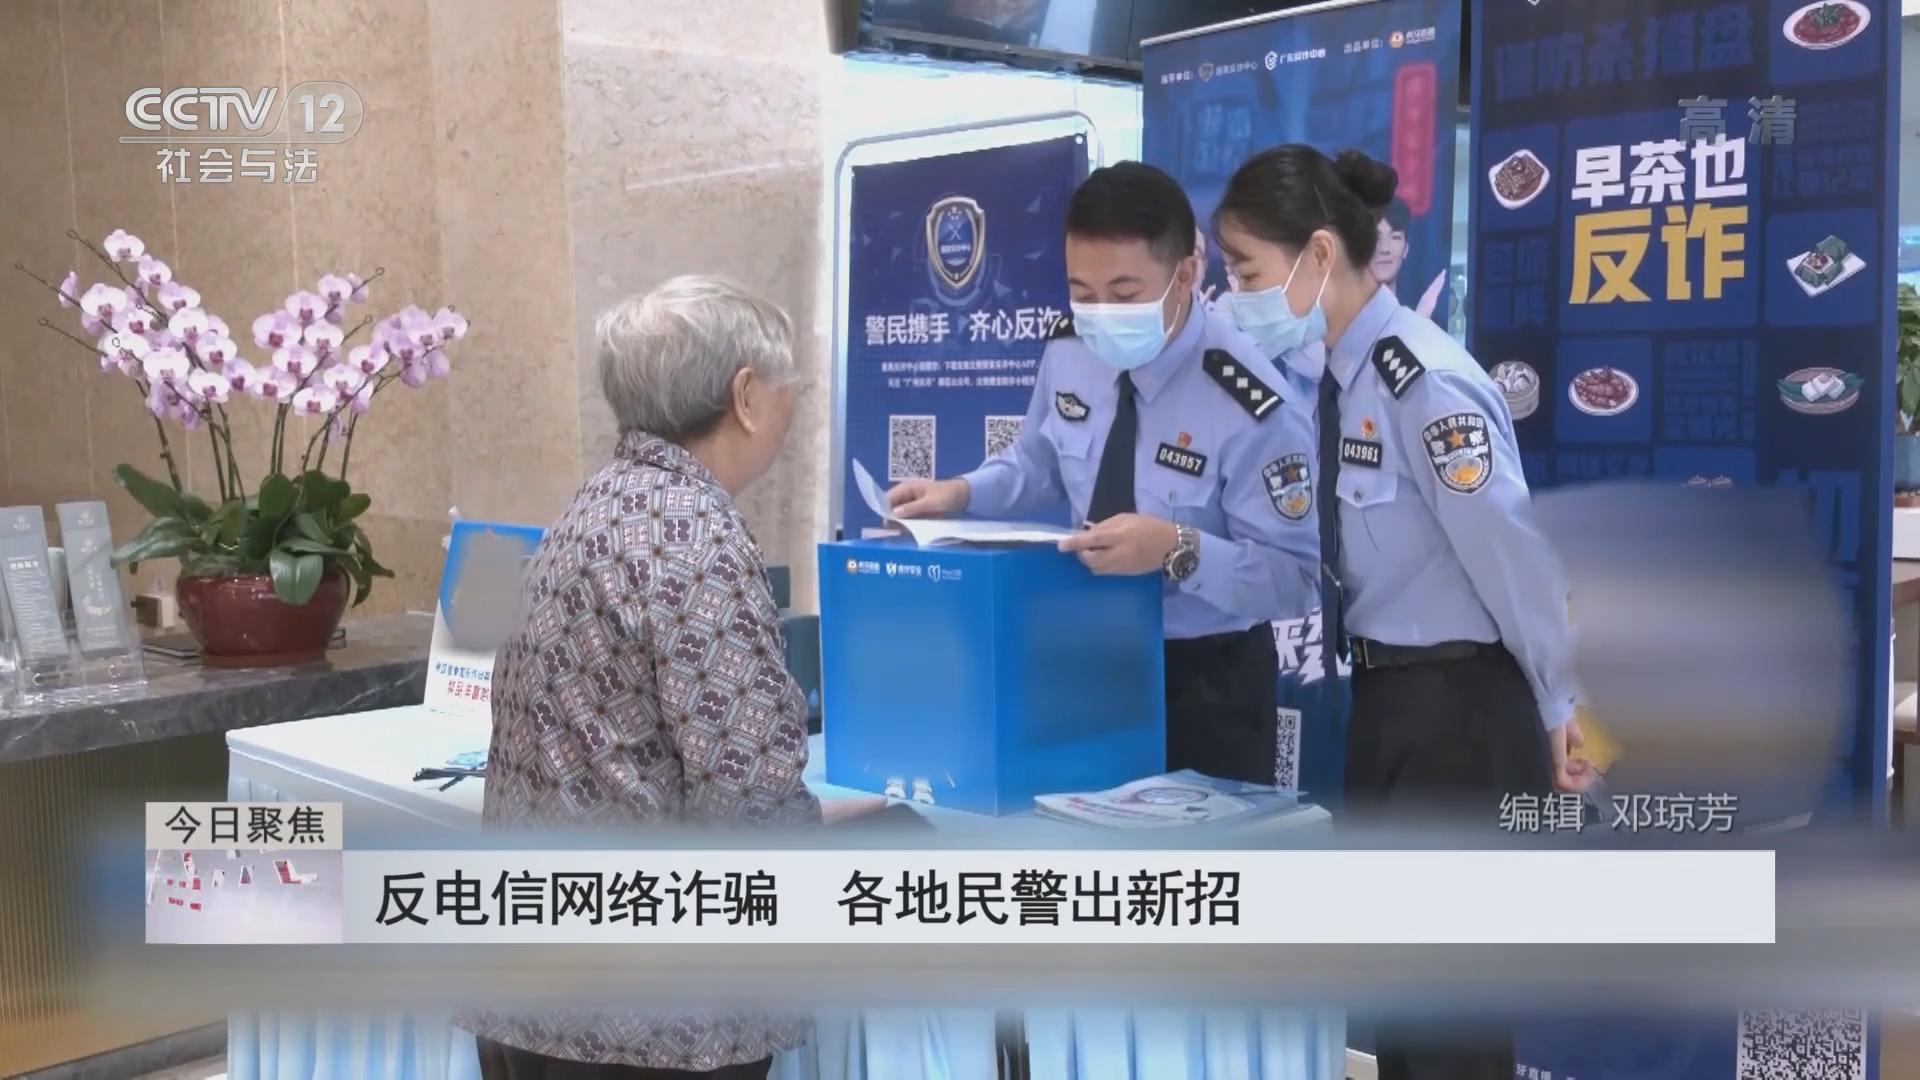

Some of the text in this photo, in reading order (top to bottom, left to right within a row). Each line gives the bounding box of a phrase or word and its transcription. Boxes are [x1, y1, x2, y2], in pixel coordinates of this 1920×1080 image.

[1571, 133, 1748, 208] 早茶也
[1569, 203, 1748, 305] 反诈
[865, 312, 950, 346] 警民携手
[1159, 448, 1202, 472] 043957
[1344, 443, 1379, 462] 043961
